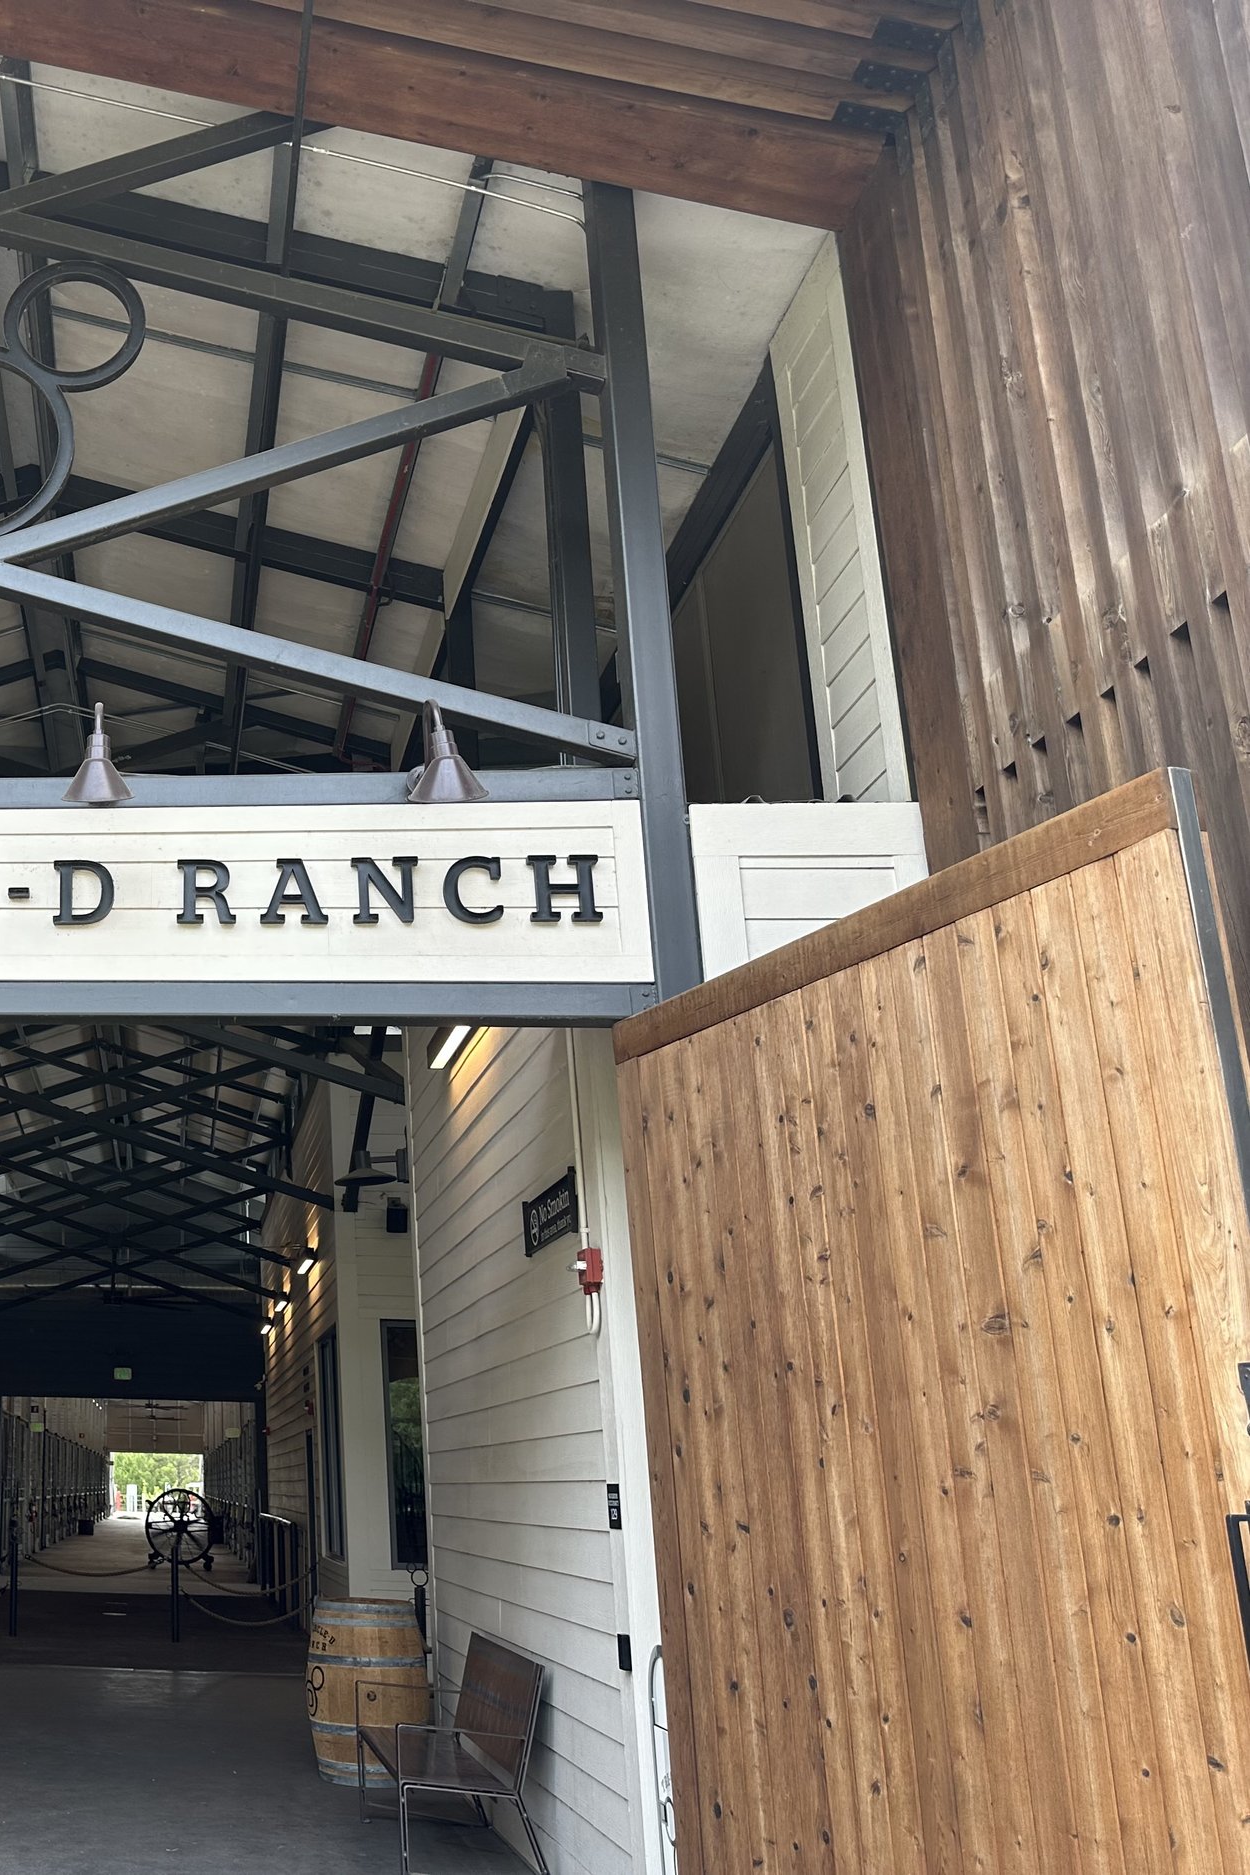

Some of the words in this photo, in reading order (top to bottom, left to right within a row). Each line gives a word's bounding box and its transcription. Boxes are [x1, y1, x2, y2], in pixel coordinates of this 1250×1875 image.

[175, 854, 603, 925] RANCH
[538, 1204, 547, 1226] No
[547, 1189, 570, 1219] Smokin
